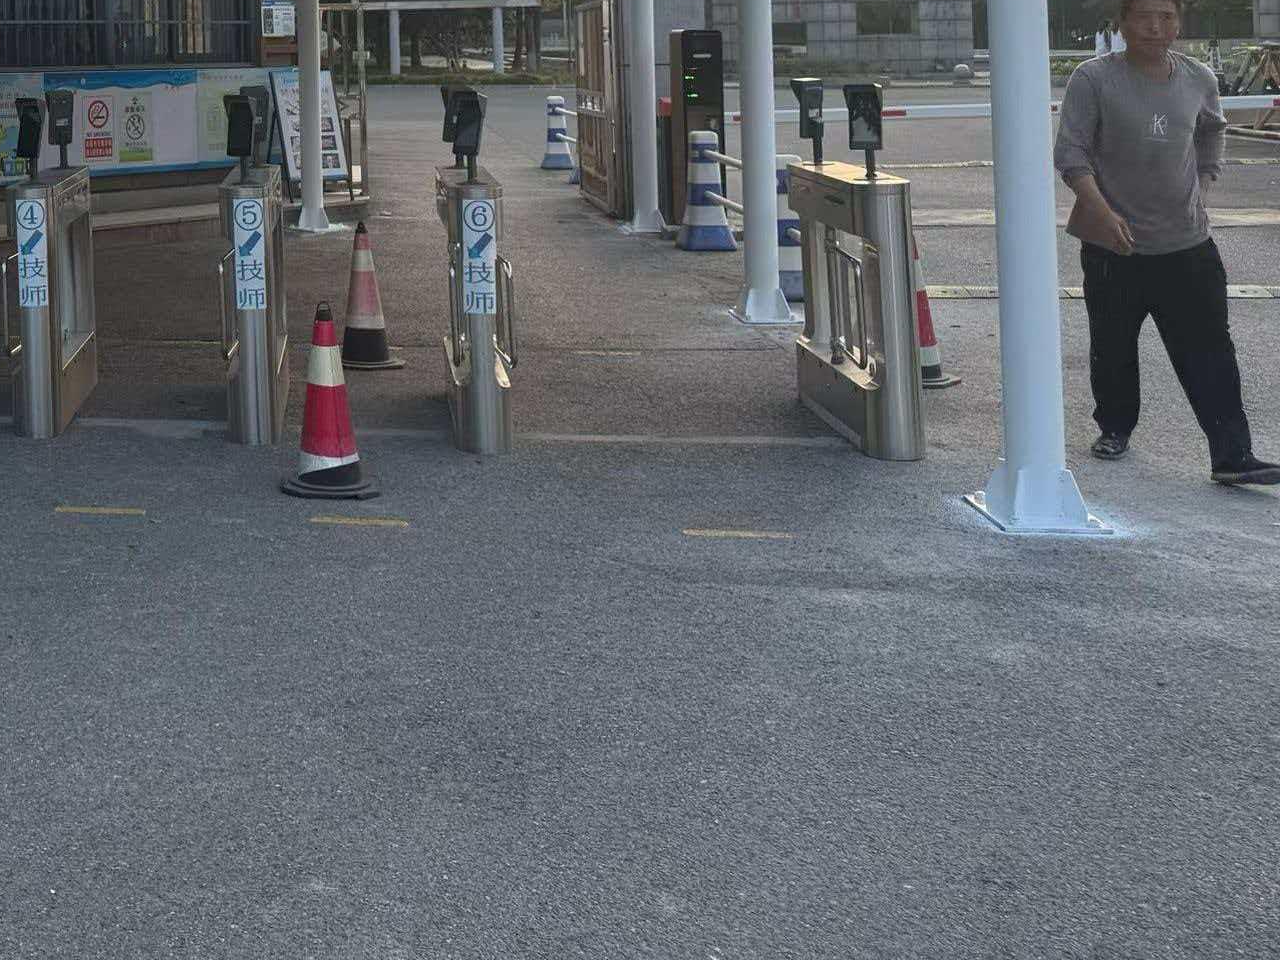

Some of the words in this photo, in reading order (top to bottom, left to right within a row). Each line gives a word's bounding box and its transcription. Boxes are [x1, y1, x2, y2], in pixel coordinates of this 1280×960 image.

[19, 257, 47, 306] 技师
[237, 259, 265, 309] 技师
[465, 263, 495, 315] 技师
